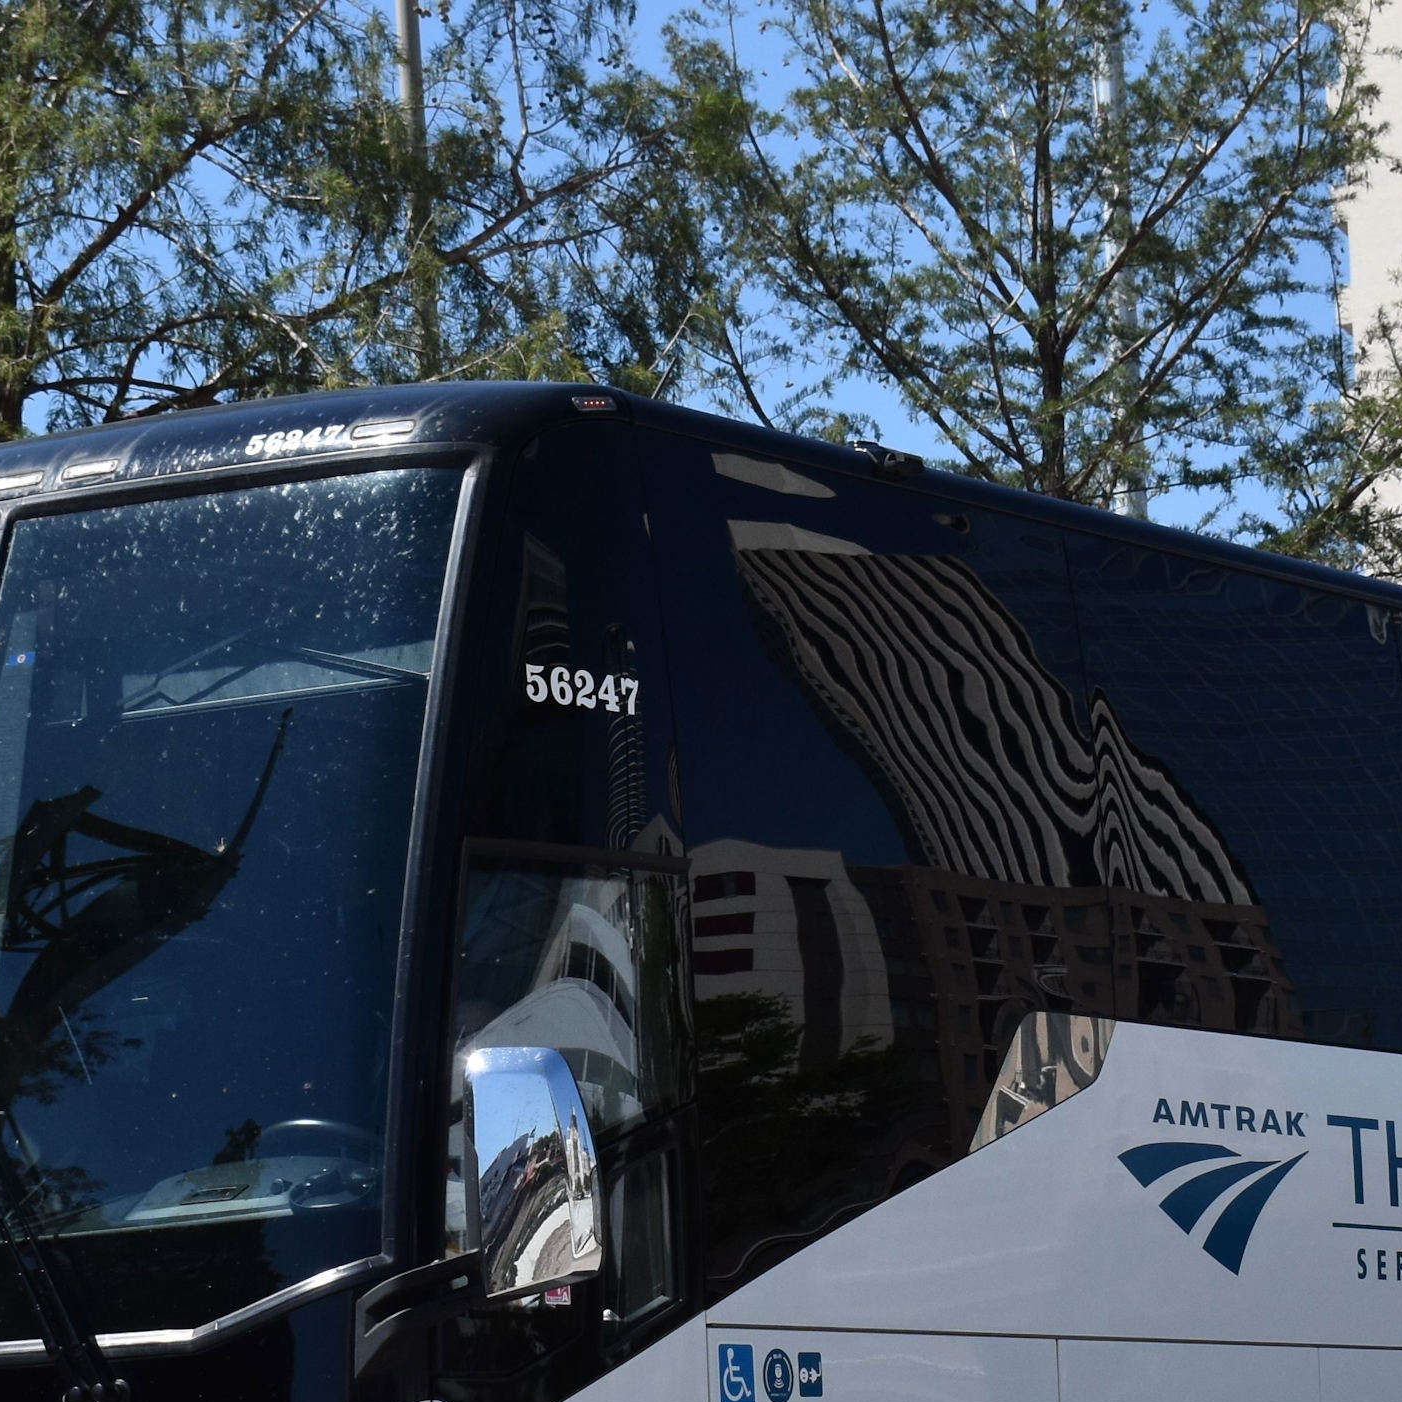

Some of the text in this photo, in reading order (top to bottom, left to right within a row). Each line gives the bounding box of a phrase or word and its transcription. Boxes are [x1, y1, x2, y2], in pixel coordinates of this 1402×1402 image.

[244, 423, 345, 456] 56247
[525, 663, 639, 716] 56247
[1152, 1097, 1307, 1137] AMTRAK
